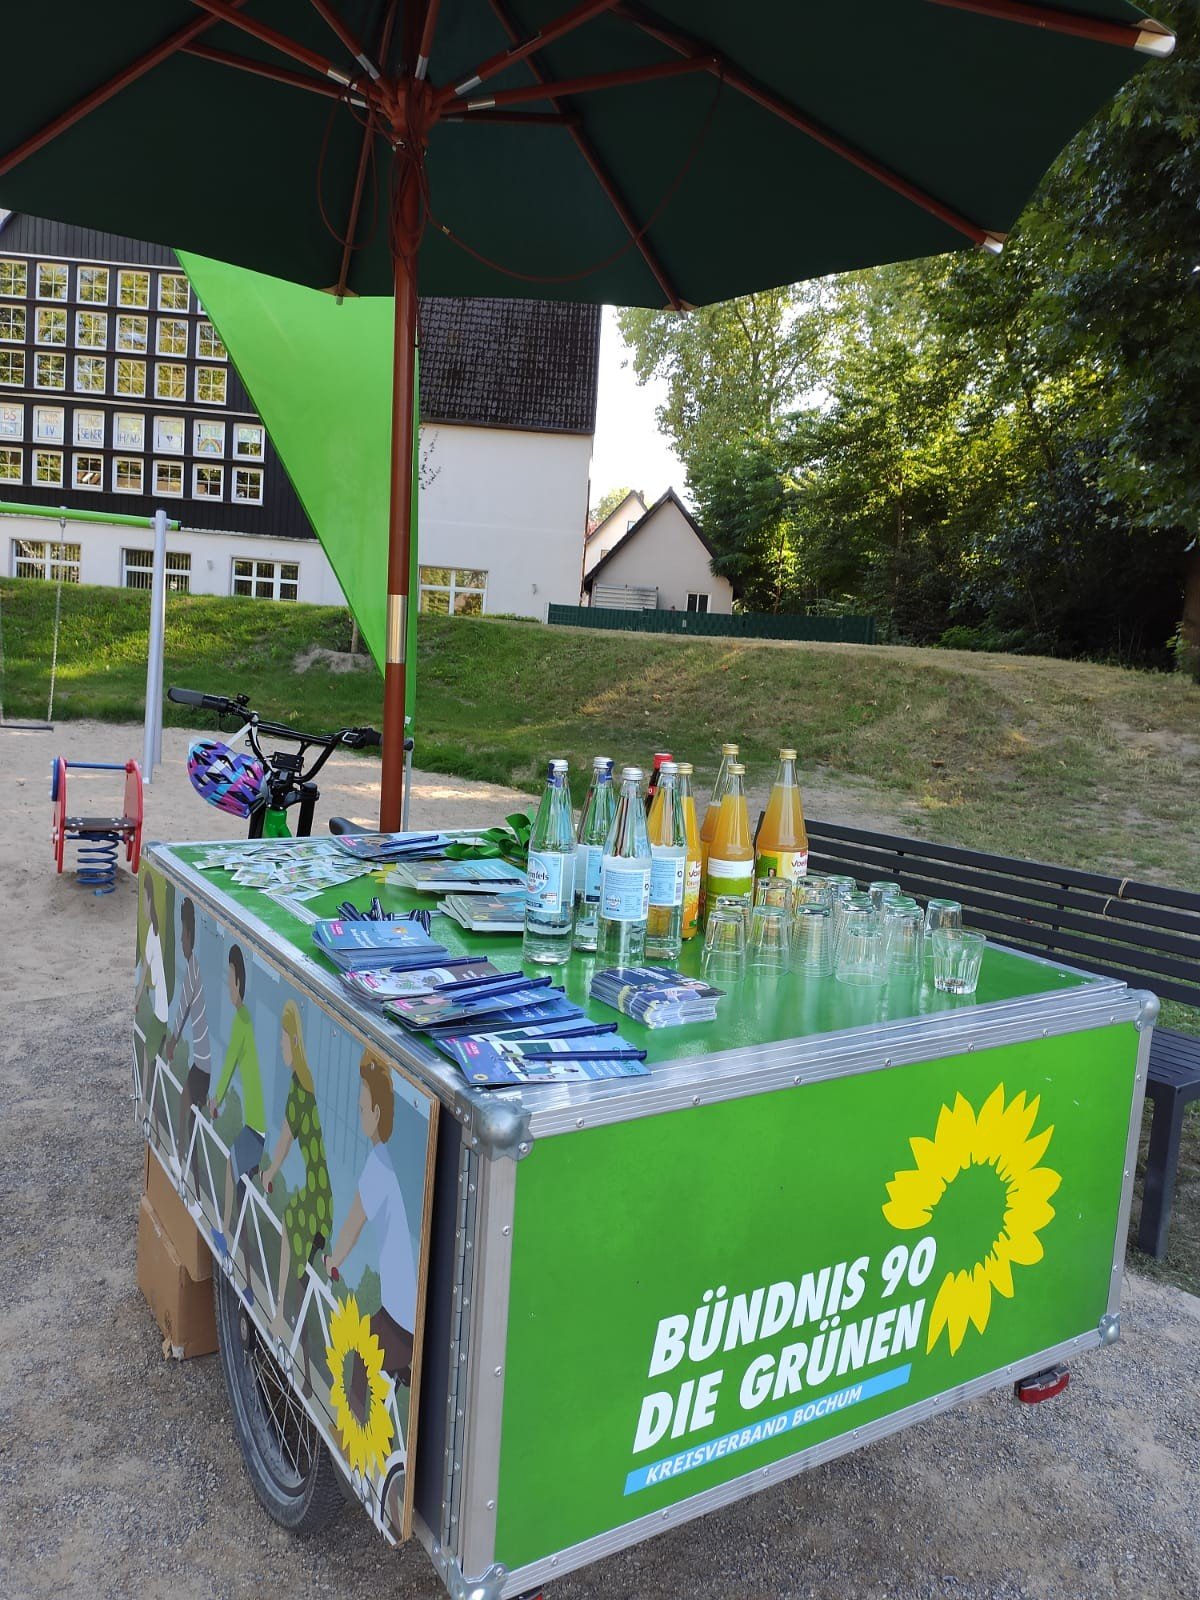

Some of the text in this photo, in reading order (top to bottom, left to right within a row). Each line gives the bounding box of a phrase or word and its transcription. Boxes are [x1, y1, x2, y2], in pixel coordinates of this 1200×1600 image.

[632, 1298, 926, 1454] DIE GRÜNEN
[648, 1236, 937, 1378] BÜNDNIS 90
[645, 1385, 863, 1485] KREISVERBAND BOCHUM
